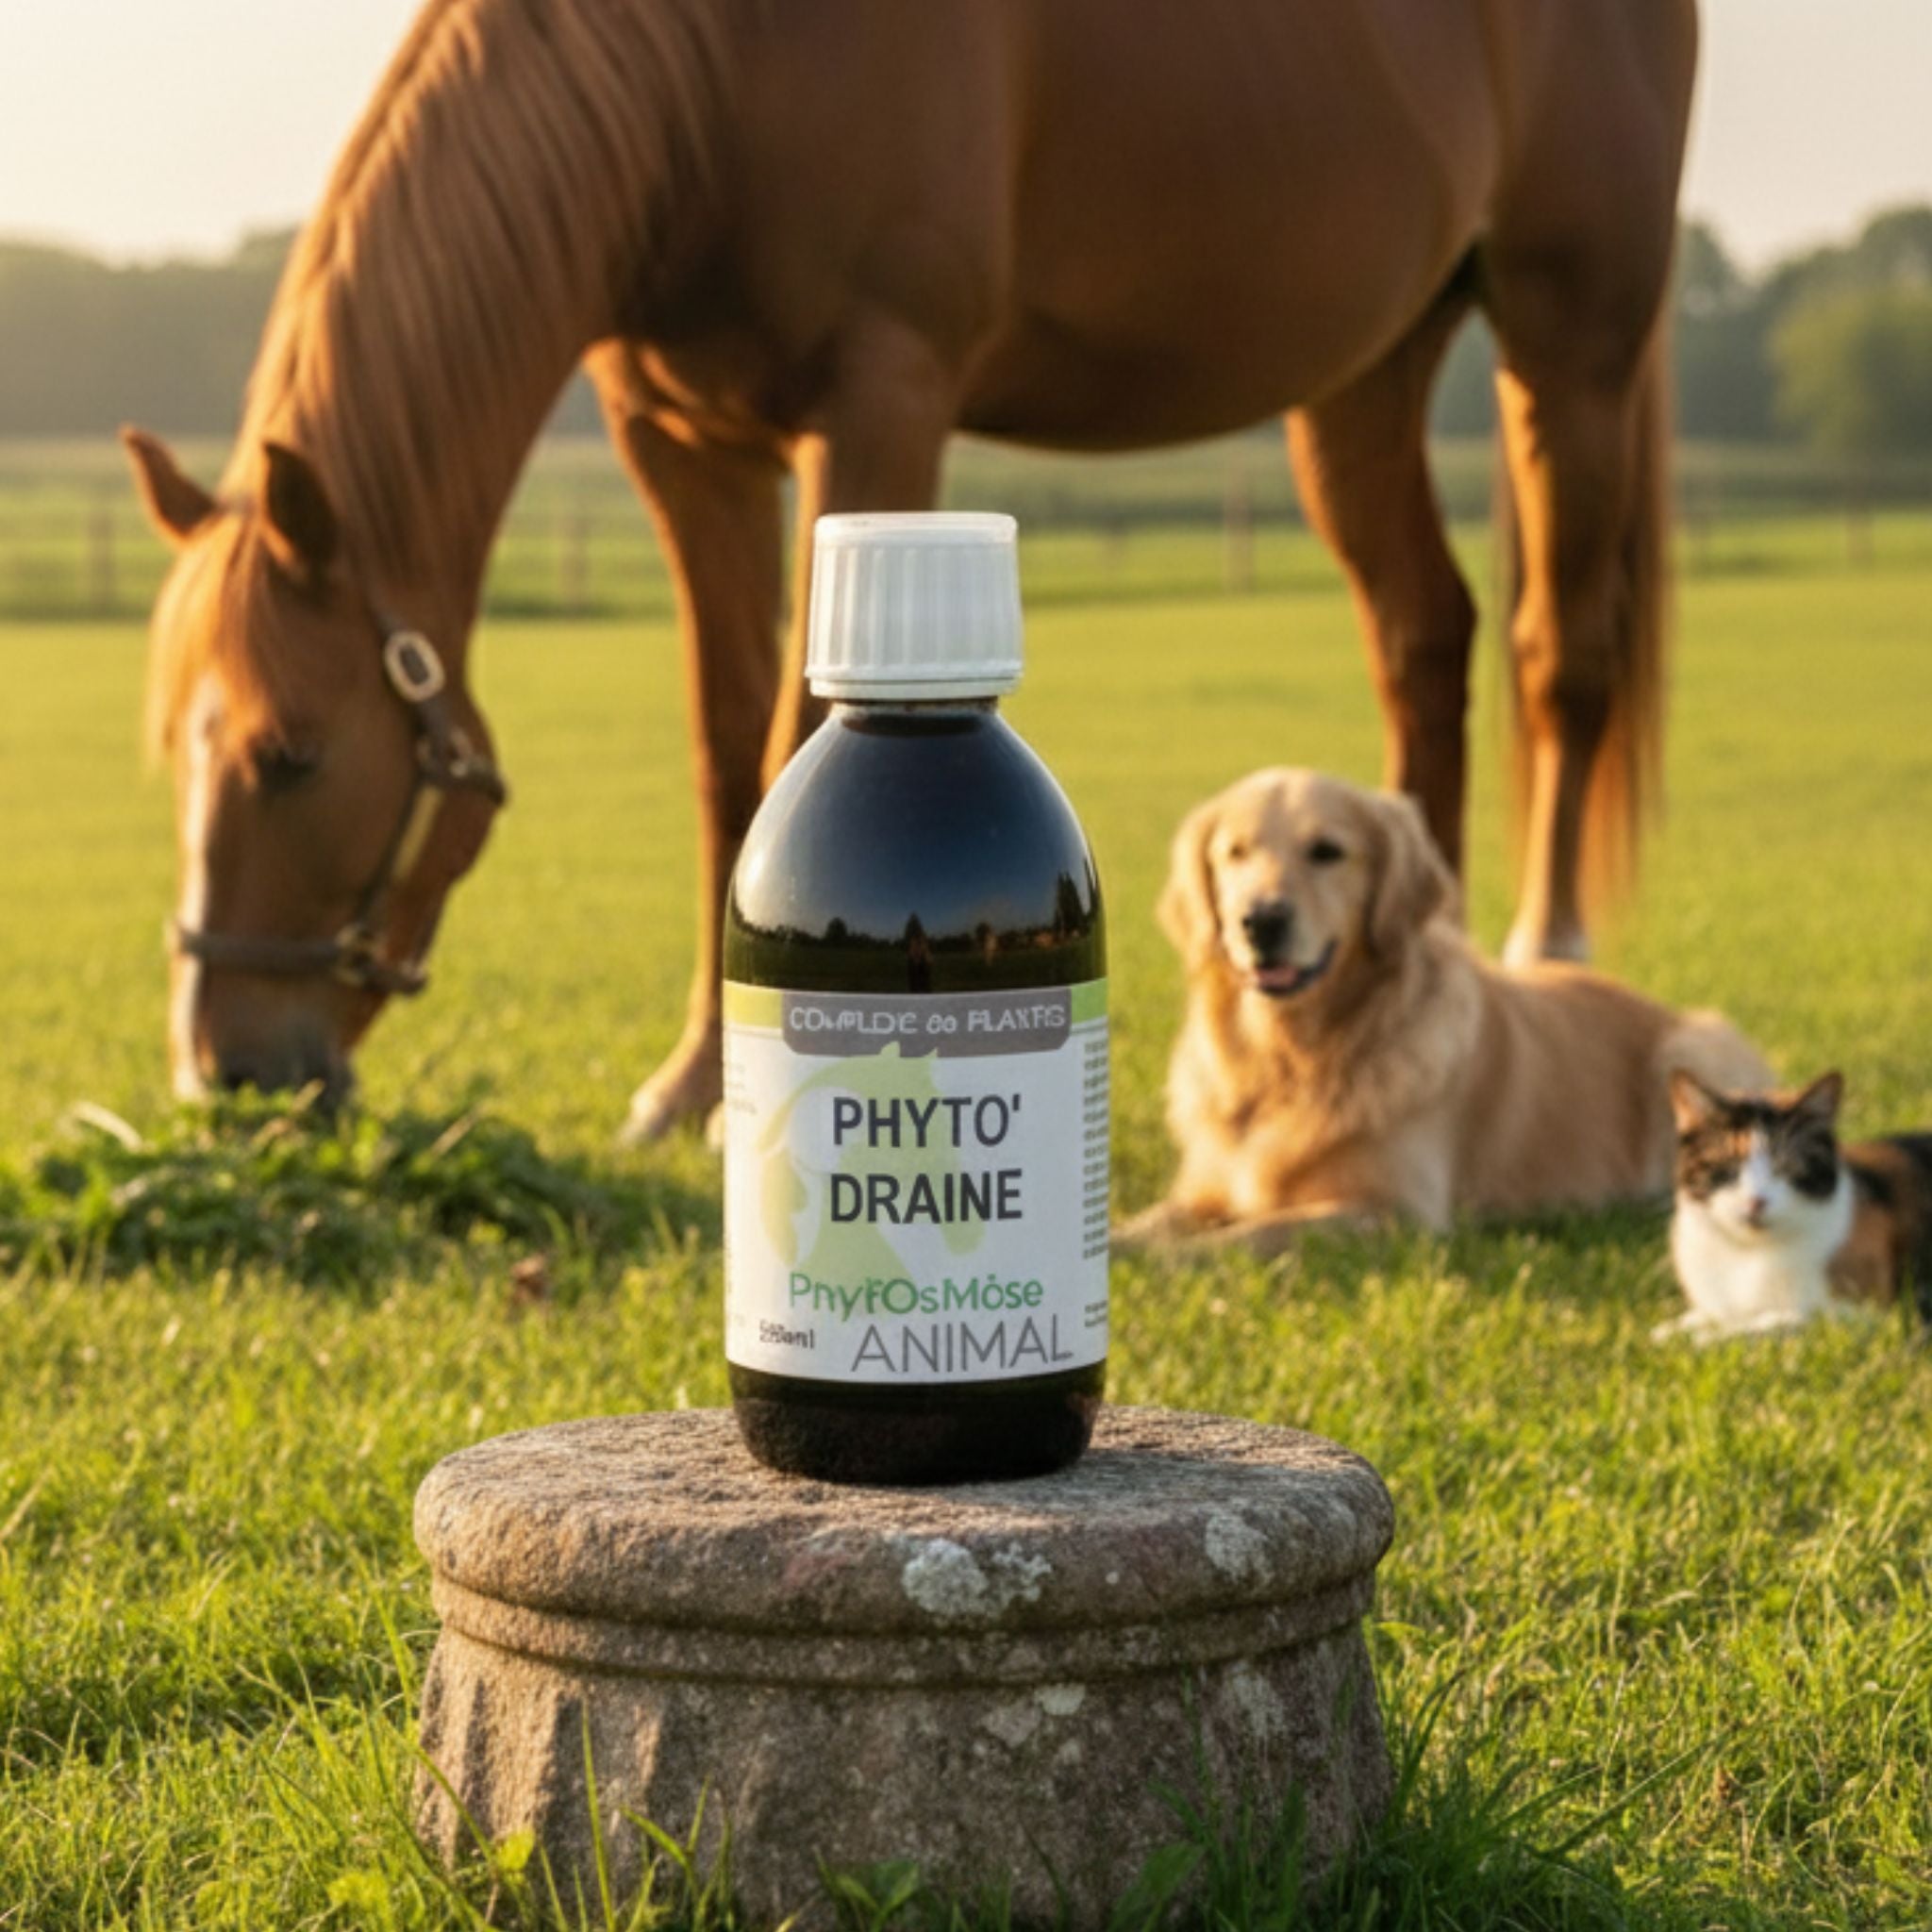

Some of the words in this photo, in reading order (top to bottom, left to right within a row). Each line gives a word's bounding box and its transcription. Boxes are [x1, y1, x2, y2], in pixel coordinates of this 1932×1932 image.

[832, 1093, 1021, 1148] PHYTO'
[830, 1169, 1023, 1224] DRAINE
[850, 1313, 1074, 1374] ANIMAL
